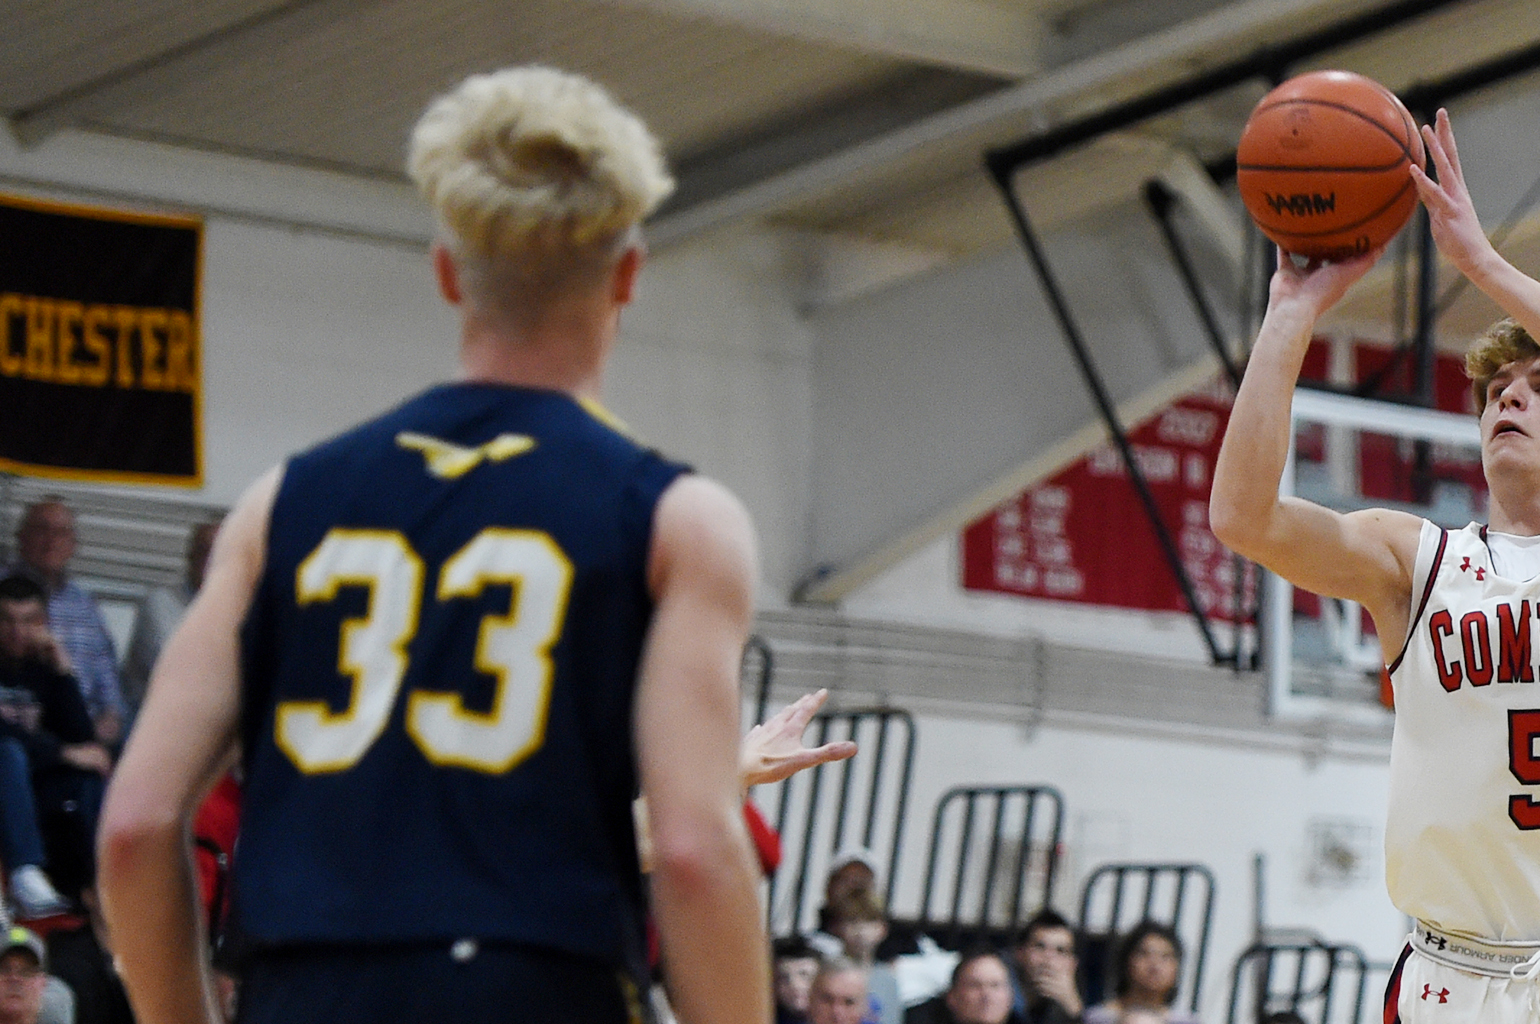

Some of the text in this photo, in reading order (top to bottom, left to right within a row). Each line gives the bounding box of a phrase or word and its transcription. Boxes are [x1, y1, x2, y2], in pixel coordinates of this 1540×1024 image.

[275, 527, 575, 776] 33
[1449, 944, 1533, 964] NDER ARMOUR
